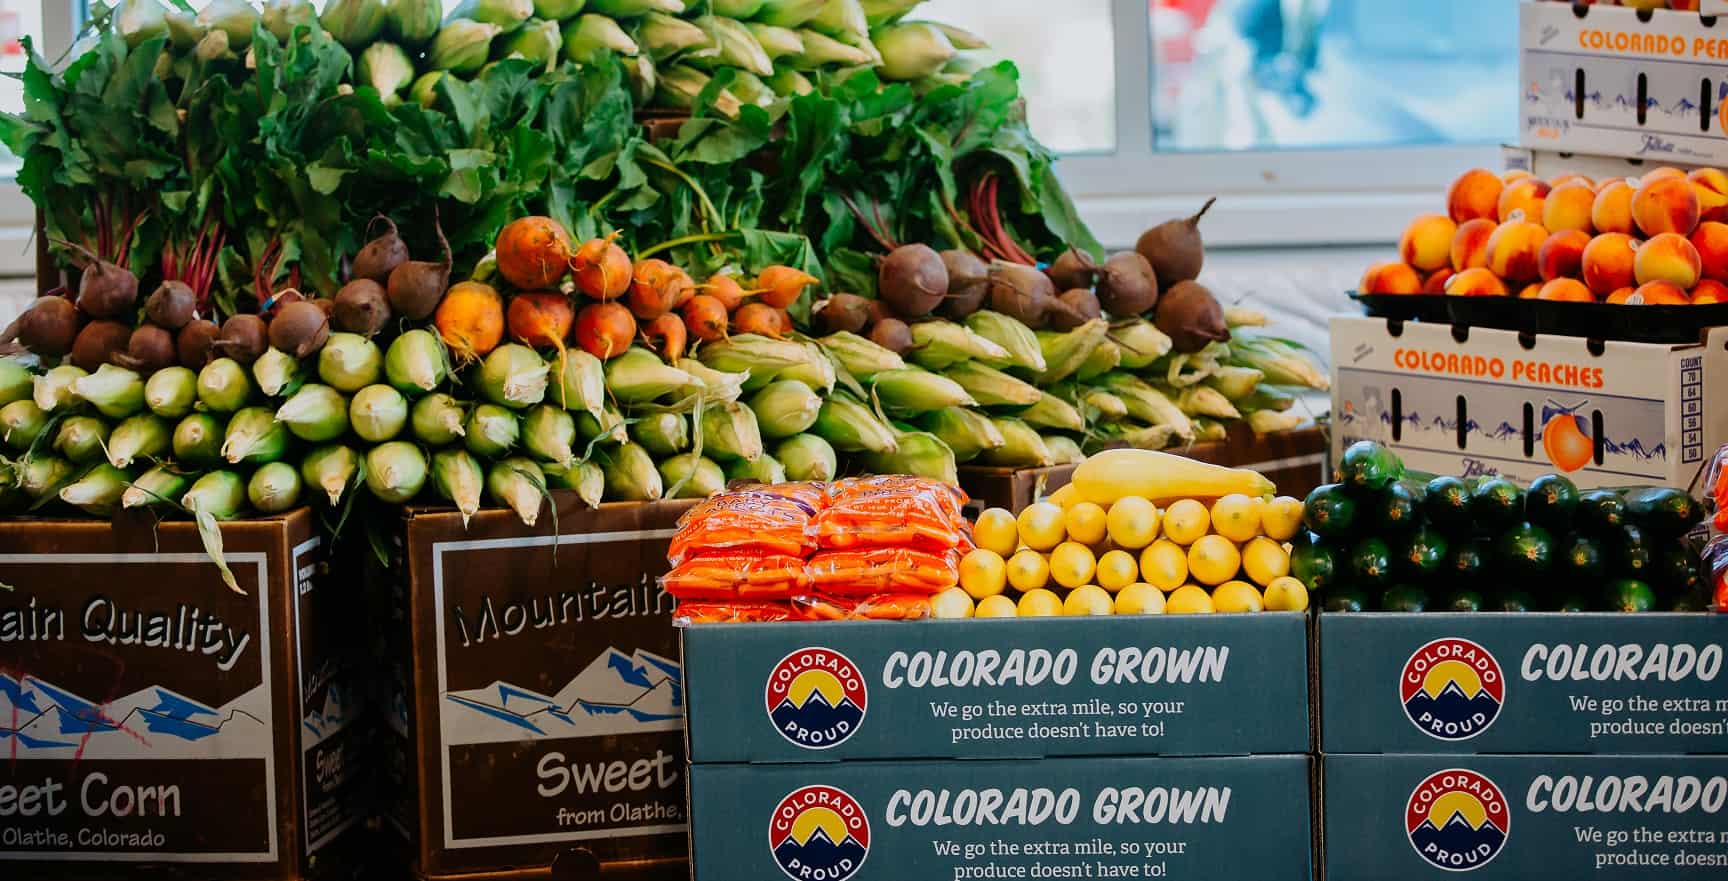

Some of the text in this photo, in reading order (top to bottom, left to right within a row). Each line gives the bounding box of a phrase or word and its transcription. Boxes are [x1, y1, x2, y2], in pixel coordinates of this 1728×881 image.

[1579, 29, 1686, 56] COLORADO
[1394, 348, 1504, 378] COLORADO
[1512, 360, 1604, 389] PEACHES
[1681, 357, 1701, 368] COUNT
[1687, 388, 1697, 397] 64
[1687, 433, 1697, 443] 54
[1687, 448, 1697, 458] 50
[455, 571, 677, 648] Mountain
[82, 599, 250, 671] Quality
[773, 653, 859, 694] COLORADO
[883, 646, 1230, 689] COLORADO GROWN
[1407, 644, 1496, 684] COLORADO
[1520, 643, 1723, 682] COLORADO
[930, 699, 1185, 720] We go the extra mile, so your
[1569, 696, 1597, 711] We
[1601, 699, 1623, 715] go
[1628, 696, 1658, 711] the
[1663, 697, 1711, 712] extra
[785, 720, 849, 743] PROUD
[952, 721, 1164, 743] produce doesn't have to!
[1419, 711, 1486, 735] PROUD
[1590, 718, 1665, 738] produce
[536, 750, 676, 797] Sweet
[81, 771, 181, 816] Corn
[1413, 775, 1502, 814] COLORADO
[1526, 774, 1728, 814] COLORADO
[556, 801, 683, 826] from Olathe,
[776, 791, 862, 831] COLORADO
[886, 787, 1232, 827] COLORADO GROWN
[3, 827, 165, 847] Olathe, Colorado
[1574, 827, 1602, 842] We
[1606, 830, 1629, 847] go
[1633, 826, 1663, 843] the
[1668, 828, 1716, 844] extra
[932, 838, 1187, 859] We go the extra mile, so your
[1424, 842, 1491, 865] PROUD
[1595, 849, 1670, 869] produce
[788, 858, 852, 881] PROUD
[954, 861, 1167, 881] produce doesn't have to!
